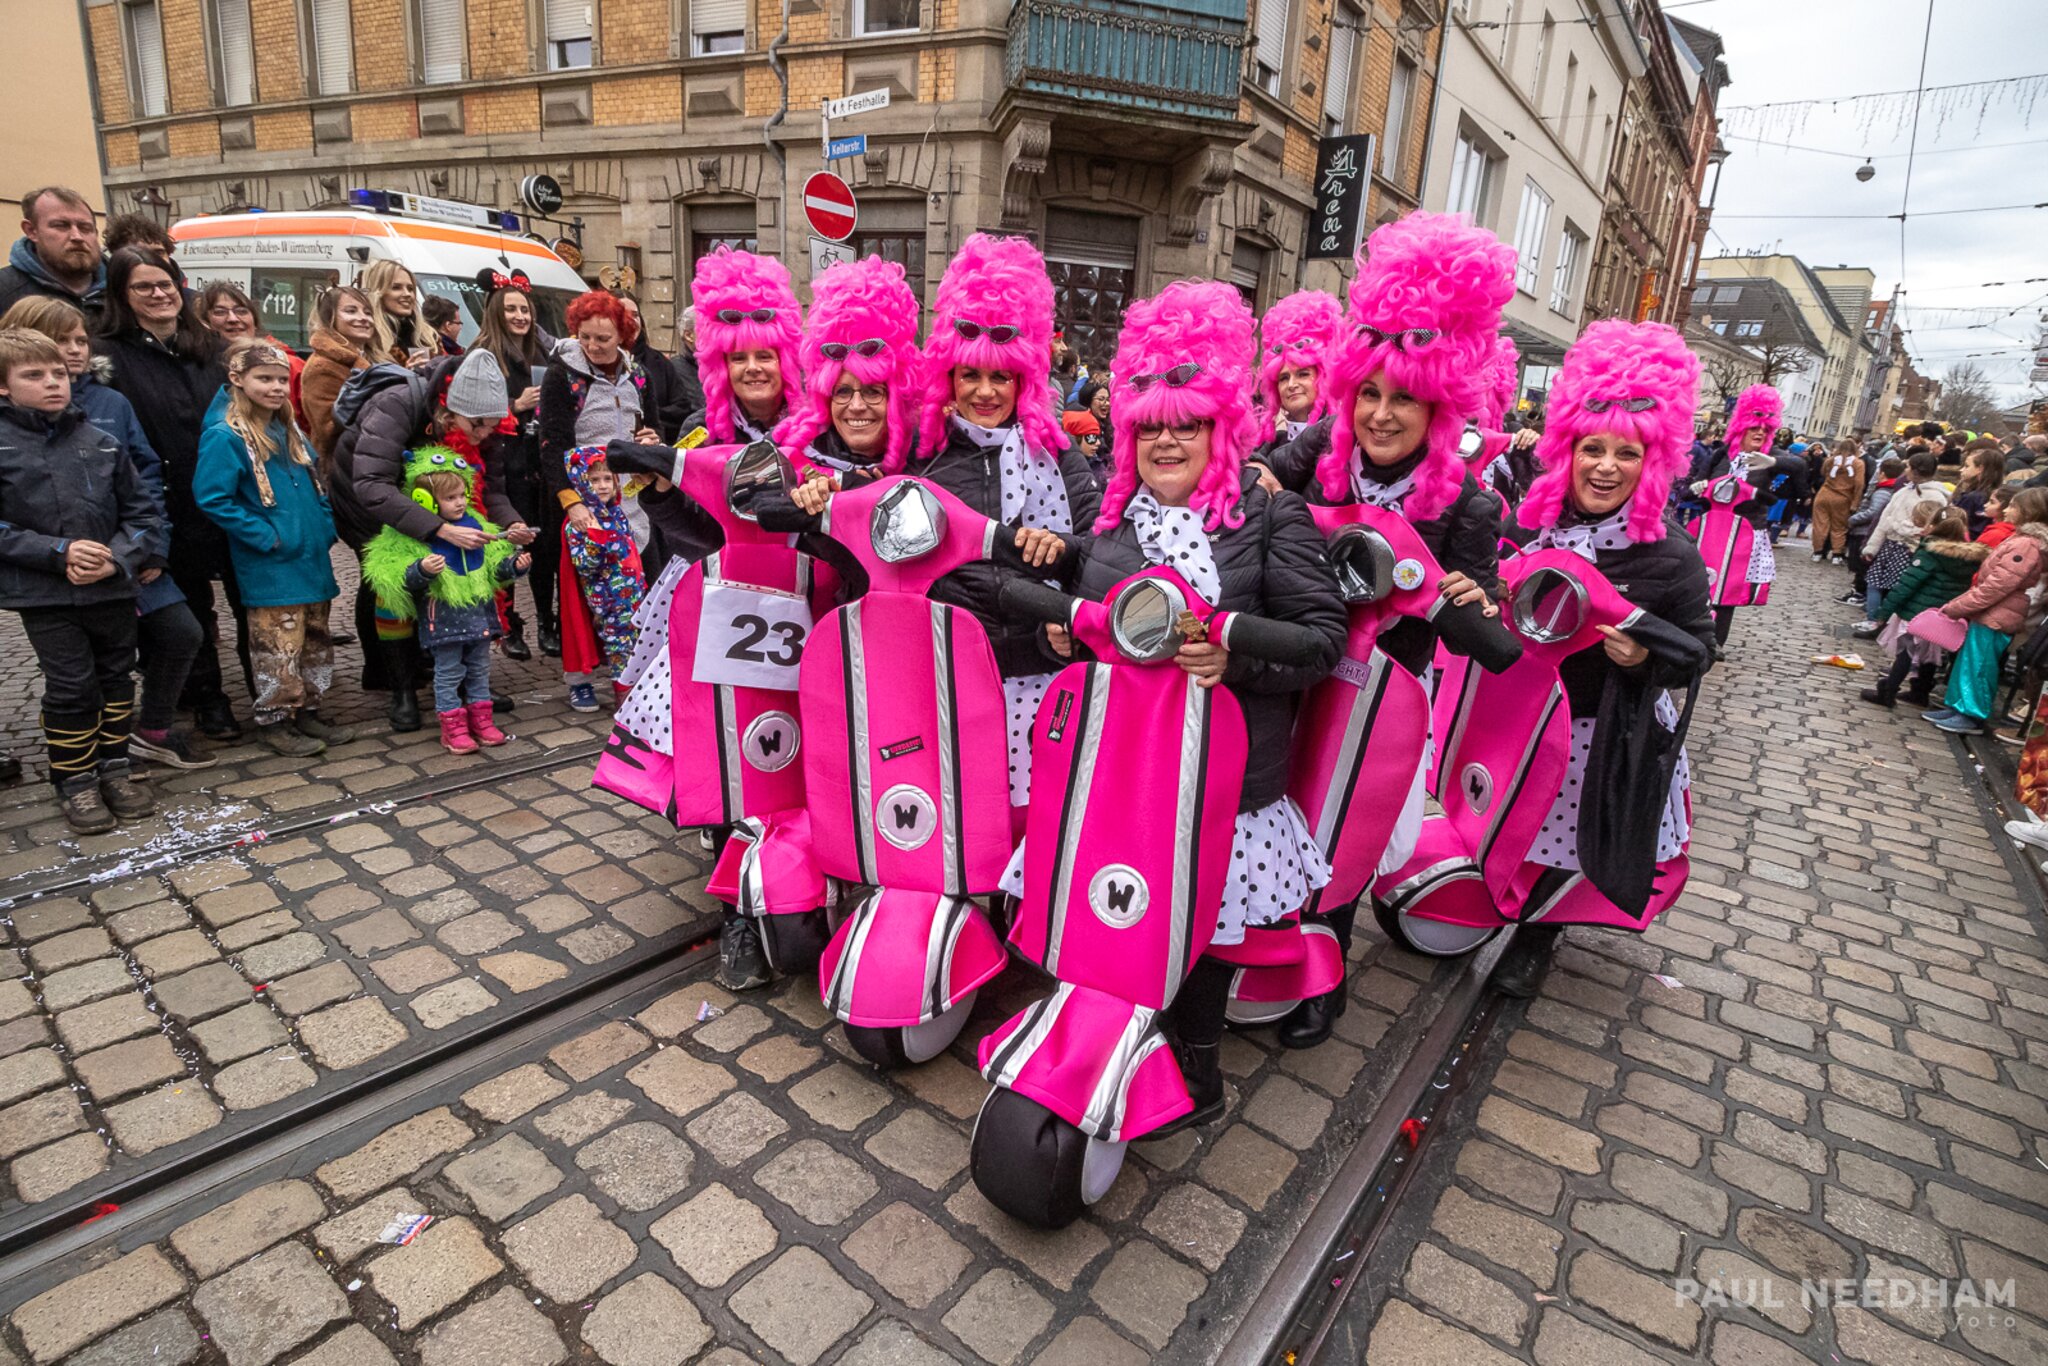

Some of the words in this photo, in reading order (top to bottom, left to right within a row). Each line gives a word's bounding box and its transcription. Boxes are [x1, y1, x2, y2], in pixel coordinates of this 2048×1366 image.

[847, 93, 886, 112] Festhalle
[189, 241, 251, 259] Bevölkerungsschutz
[255, 240, 334, 259] Baden-Württemberg
[273, 294, 296, 316] 112
[725, 613, 806, 667] 23
[758, 729, 781, 757] W
[1470, 774, 1484, 801] W
[893, 803, 918, 829] W
[1108, 880, 1135, 913] W
